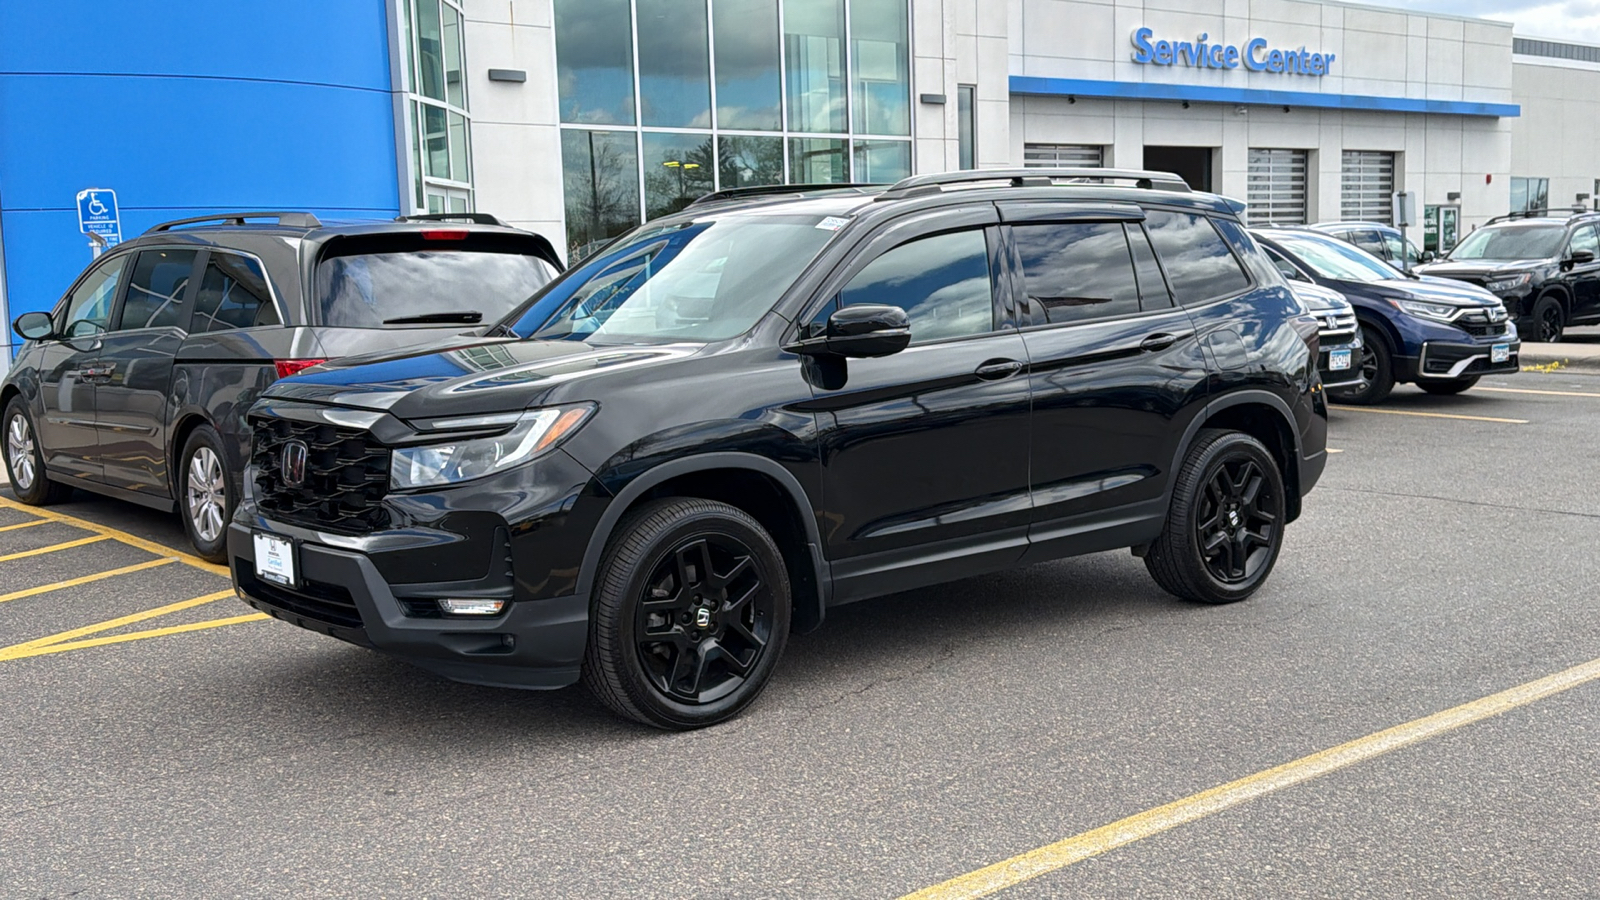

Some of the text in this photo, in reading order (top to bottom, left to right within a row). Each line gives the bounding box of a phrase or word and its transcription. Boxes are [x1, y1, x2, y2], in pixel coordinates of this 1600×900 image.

[1131, 27, 1335, 76] Service Center
[267, 558, 283, 567] Certified
